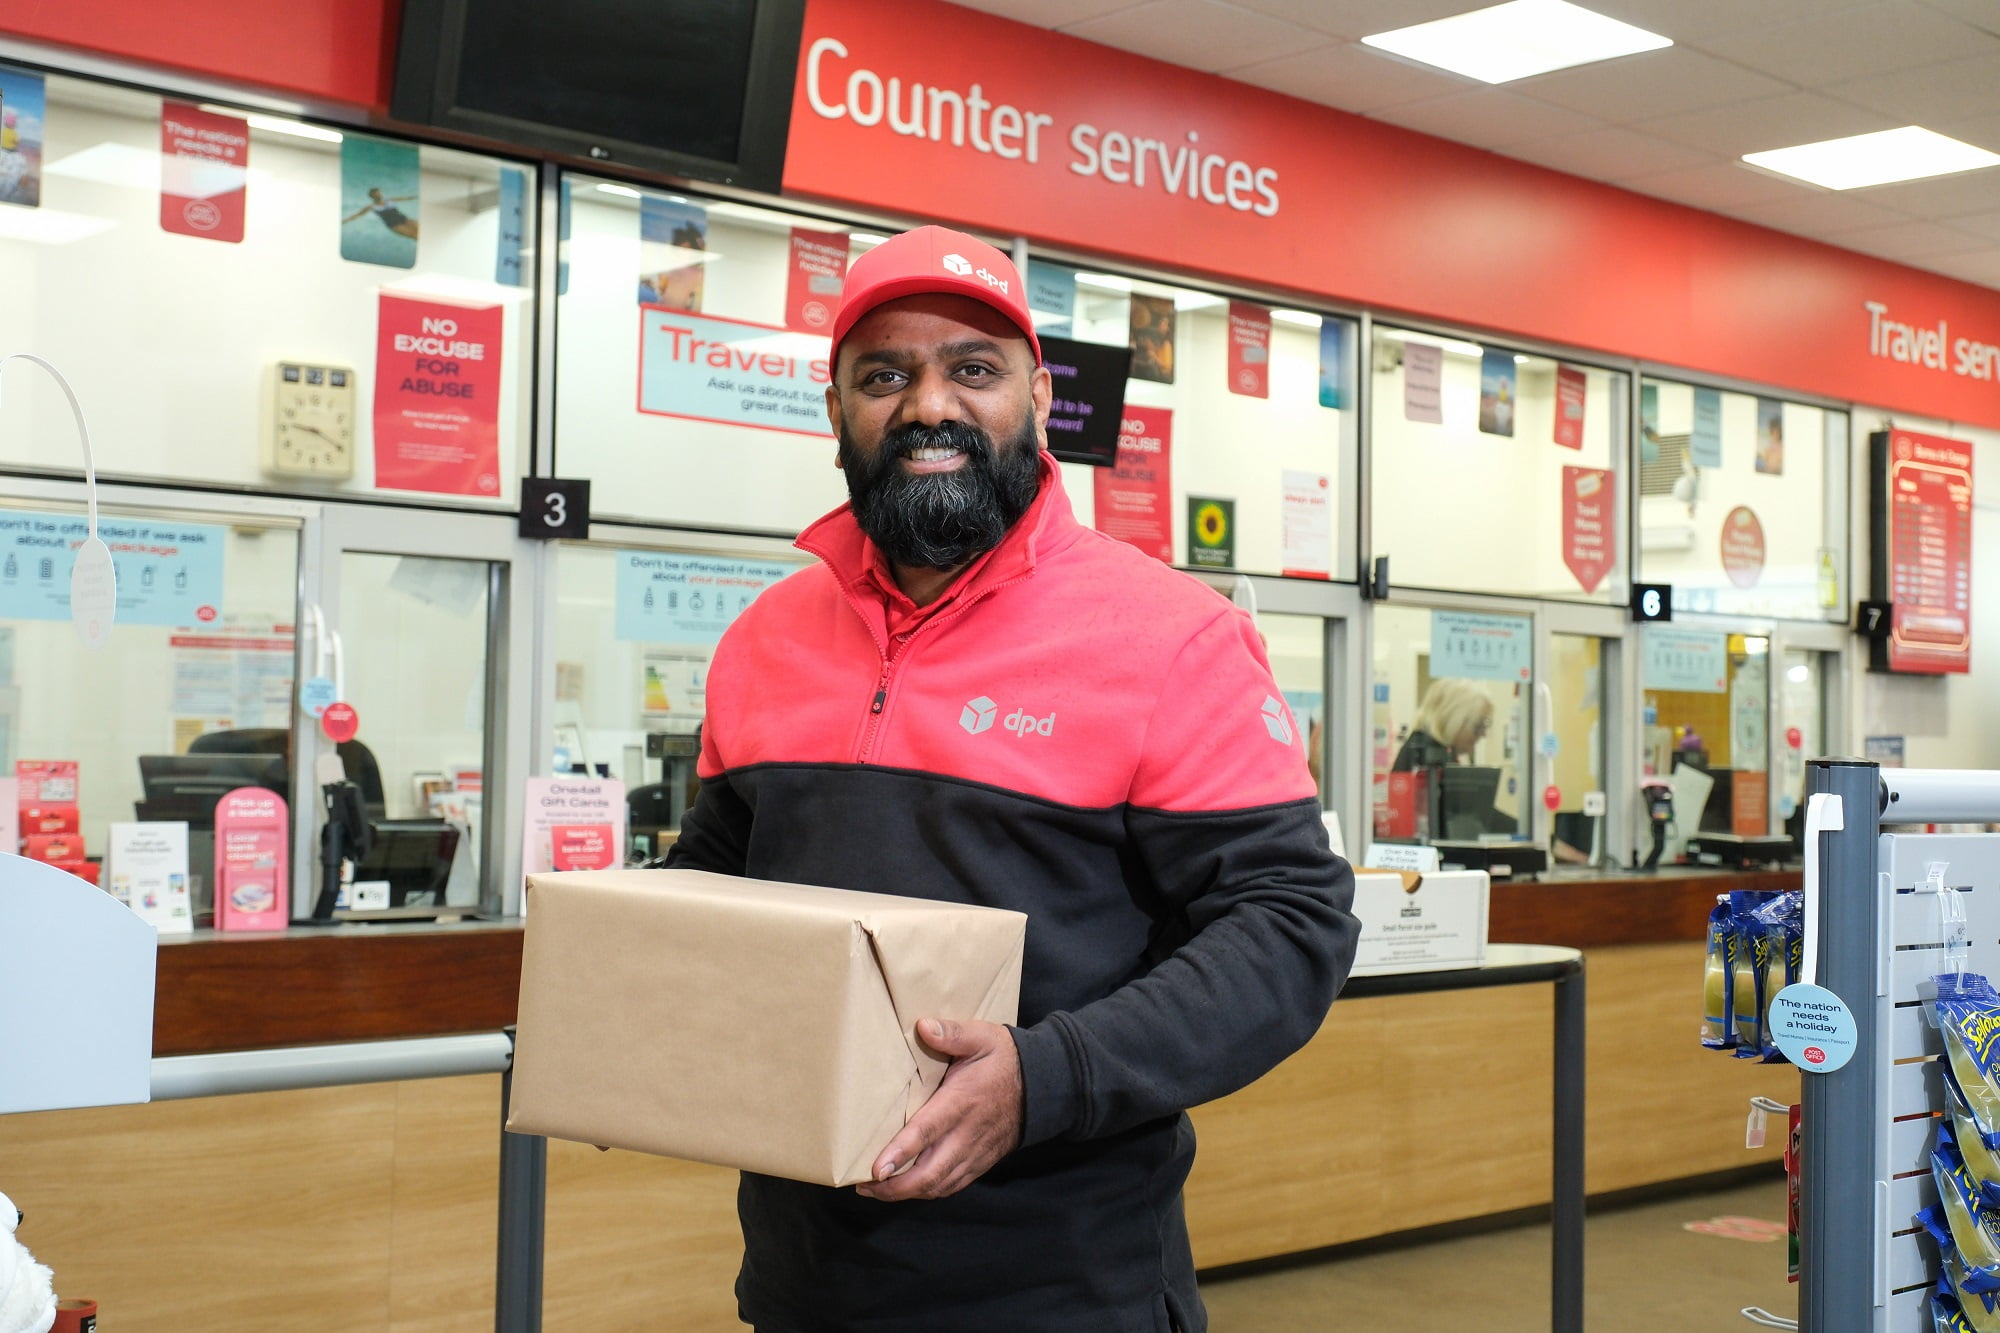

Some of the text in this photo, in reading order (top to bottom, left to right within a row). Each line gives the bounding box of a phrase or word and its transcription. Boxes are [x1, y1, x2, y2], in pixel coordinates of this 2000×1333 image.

[164, 120, 196, 138] The
[805, 37, 1280, 217] Counter services
[976, 268, 1008, 295] dpd
[421, 317, 458, 337] NO
[1864, 300, 1947, 371] Travel
[394, 333, 484, 360] EXCUSE
[659, 324, 831, 384] Travel s
[415, 357, 460, 377] FOR
[400, 377, 474, 399] ABUSE
[707, 376, 735, 393] Ask
[738, 382, 756, 394] us
[759, 383, 799, 400] about
[740, 399, 819, 418] great deals
[543, 493, 567, 527] 3
[0, 518, 31, 532] on't
[34, 521, 56, 533] be
[139, 527, 152, 539] if
[152, 532, 176, 541] we
[179, 532, 206, 543] ask
[16, 535, 66, 549] about
[109, 543, 179, 556] package
[630, 556, 663, 569] Don't
[664, 558, 680, 570] be
[682, 560, 735, 575] offended
[747, 567, 763, 576] we
[765, 567, 784, 578] ask
[652, 571, 687, 584] about
[1642, 589, 1661, 617] 6
[1867, 608, 1882, 632] 7
[1003, 707, 1057, 739] dpd
[550, 784, 602, 794] One4all
[229, 797, 275, 810] Pick up
[237, 808, 276, 818] leaflet
[540, 797, 610, 808] Gift Cards
[1778, 998, 1841, 1012] The nation
[1792, 1011, 1829, 1022] needs
[1795, 1020, 1837, 1034] holiday
[1805, 1053, 1824, 1061] OFFICE
